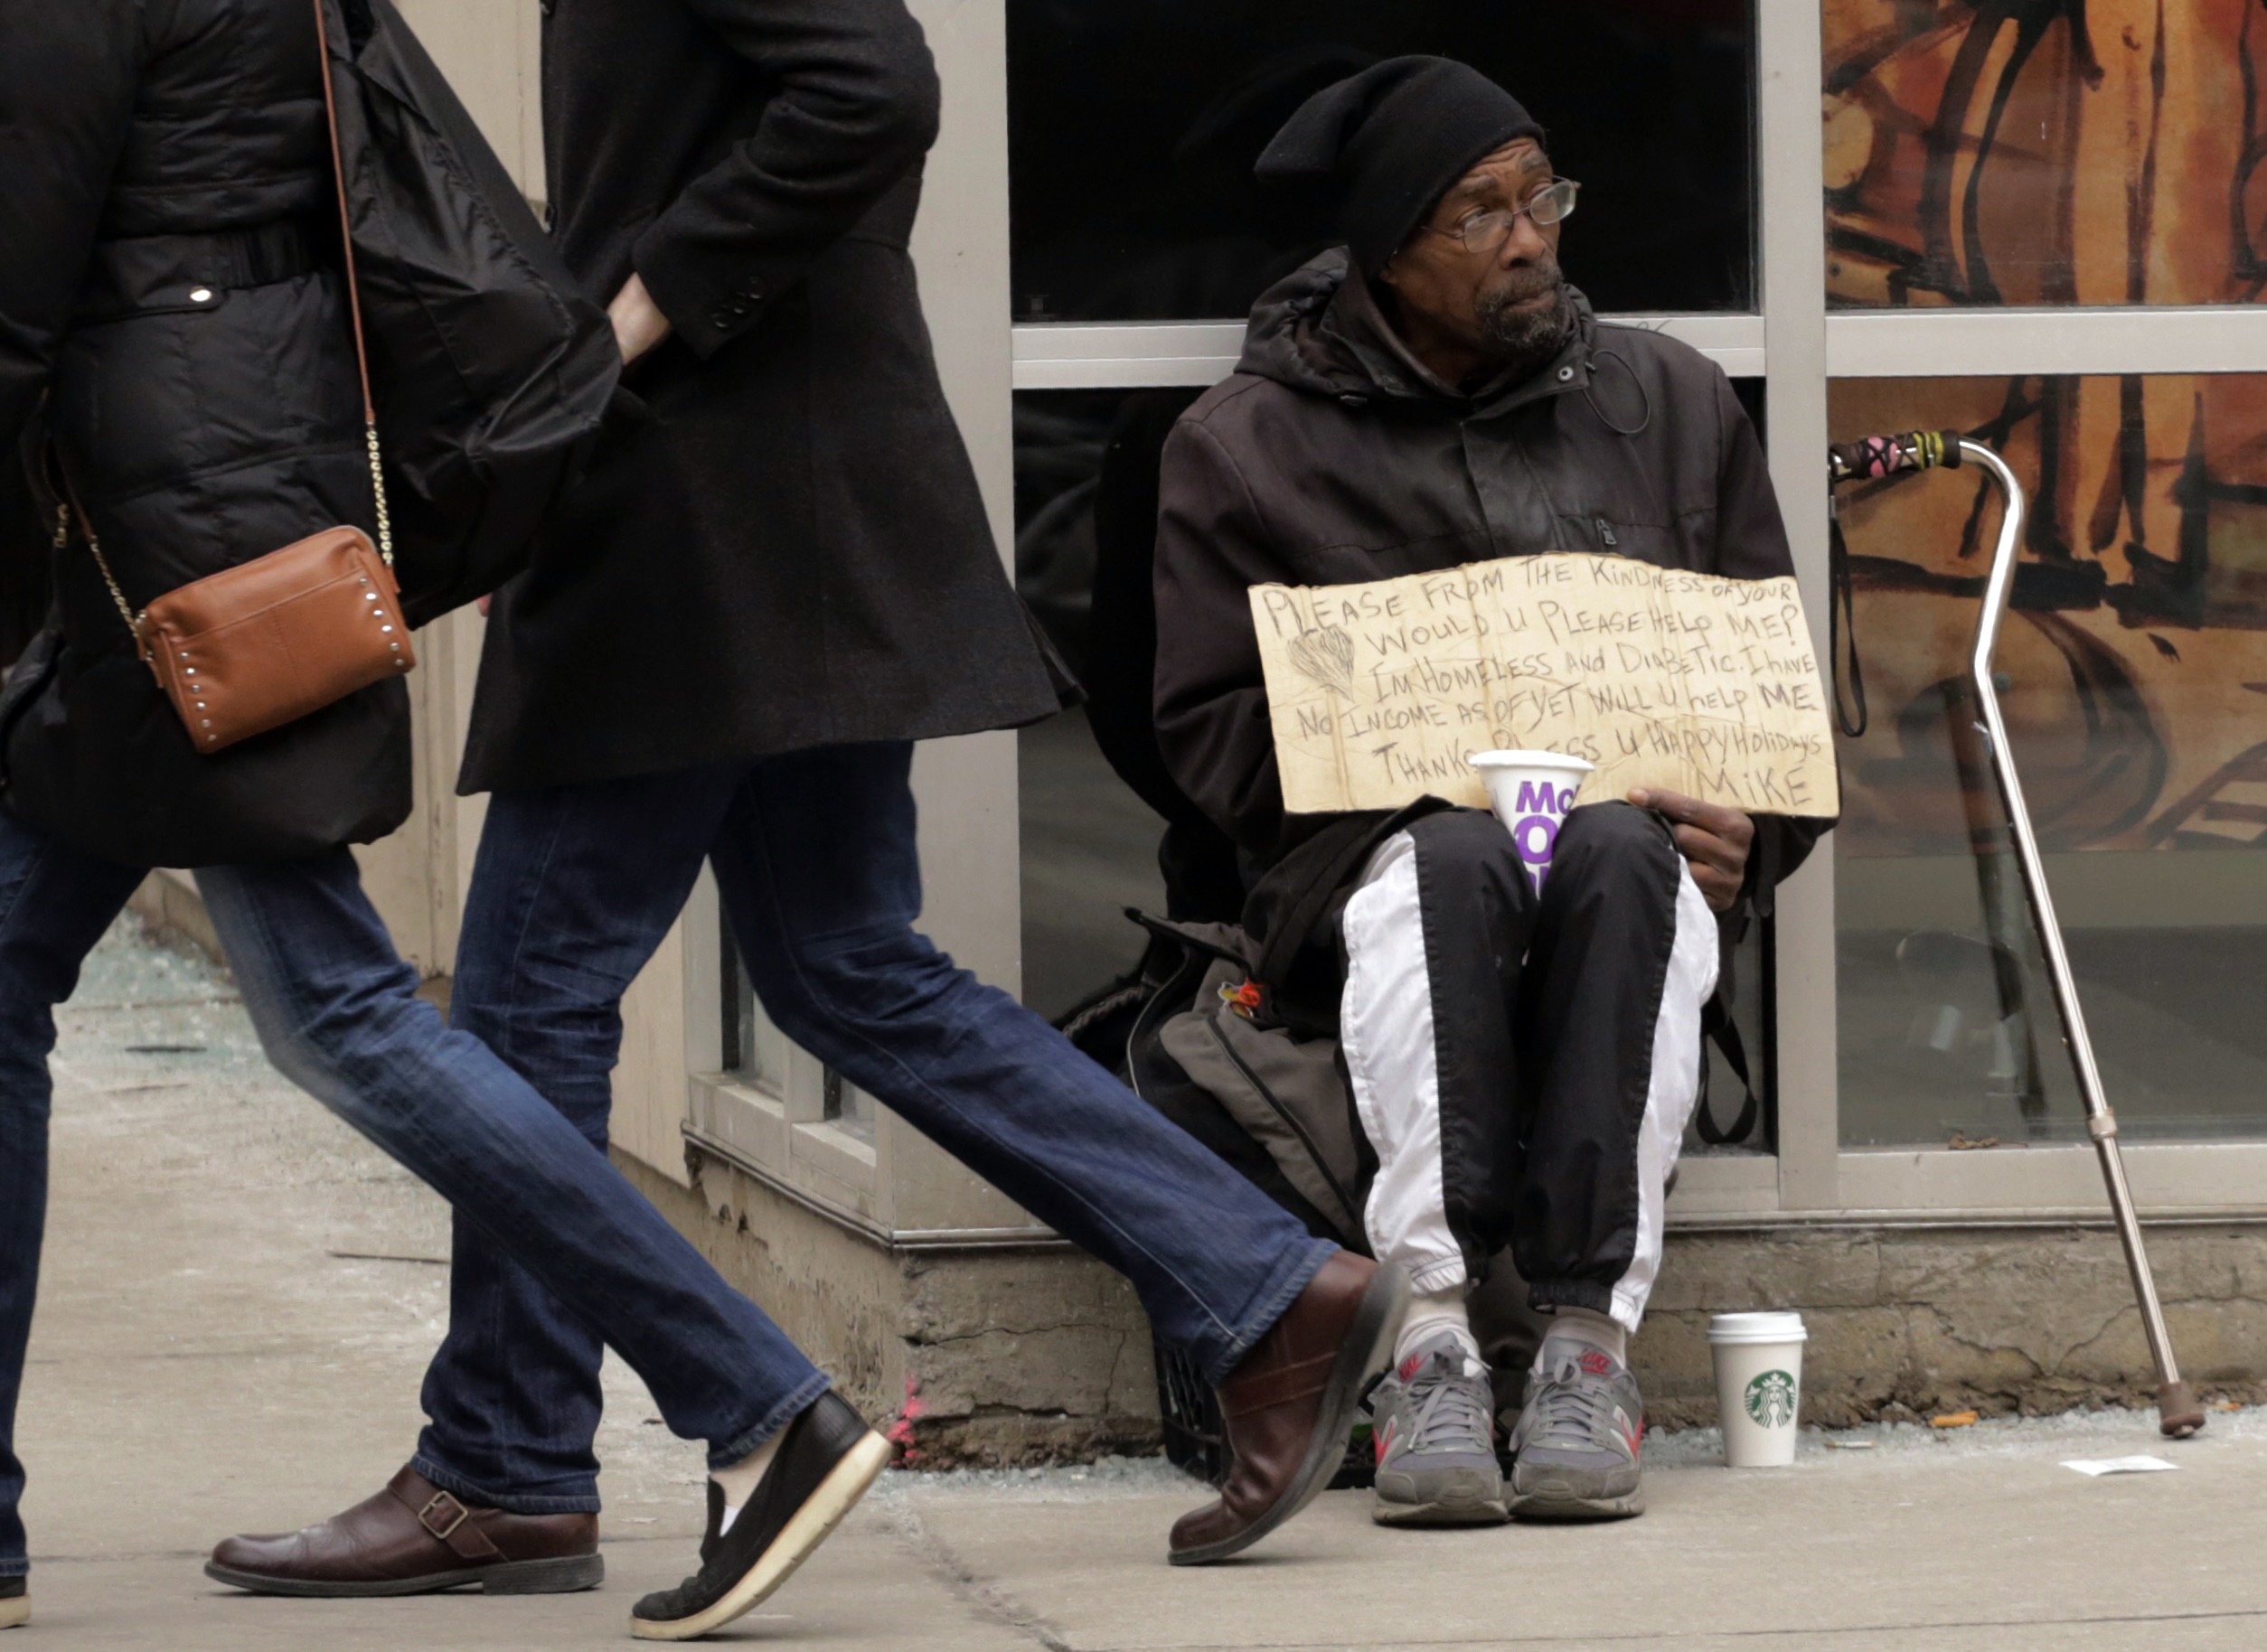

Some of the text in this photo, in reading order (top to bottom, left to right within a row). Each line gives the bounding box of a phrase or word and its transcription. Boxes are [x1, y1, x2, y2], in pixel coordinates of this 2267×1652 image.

[1263, 589, 1410, 636] PLEASE
[1422, 566, 1504, 610] FROM
[1516, 555, 1573, 588] THE
[1365, 614, 1490, 655] WOULD
[1538, 600, 1644, 645] PLEASE
[1725, 604, 1799, 646] ME?
[1369, 661, 1413, 704] IM
[1414, 652, 1553, 694] HOMELESS
[1738, 643, 1764, 676] I
[1338, 704, 1448, 739] INCOME
[1456, 701, 1490, 726] AS
[1494, 690, 1528, 723] OF
[1525, 680, 1585, 735] YET
